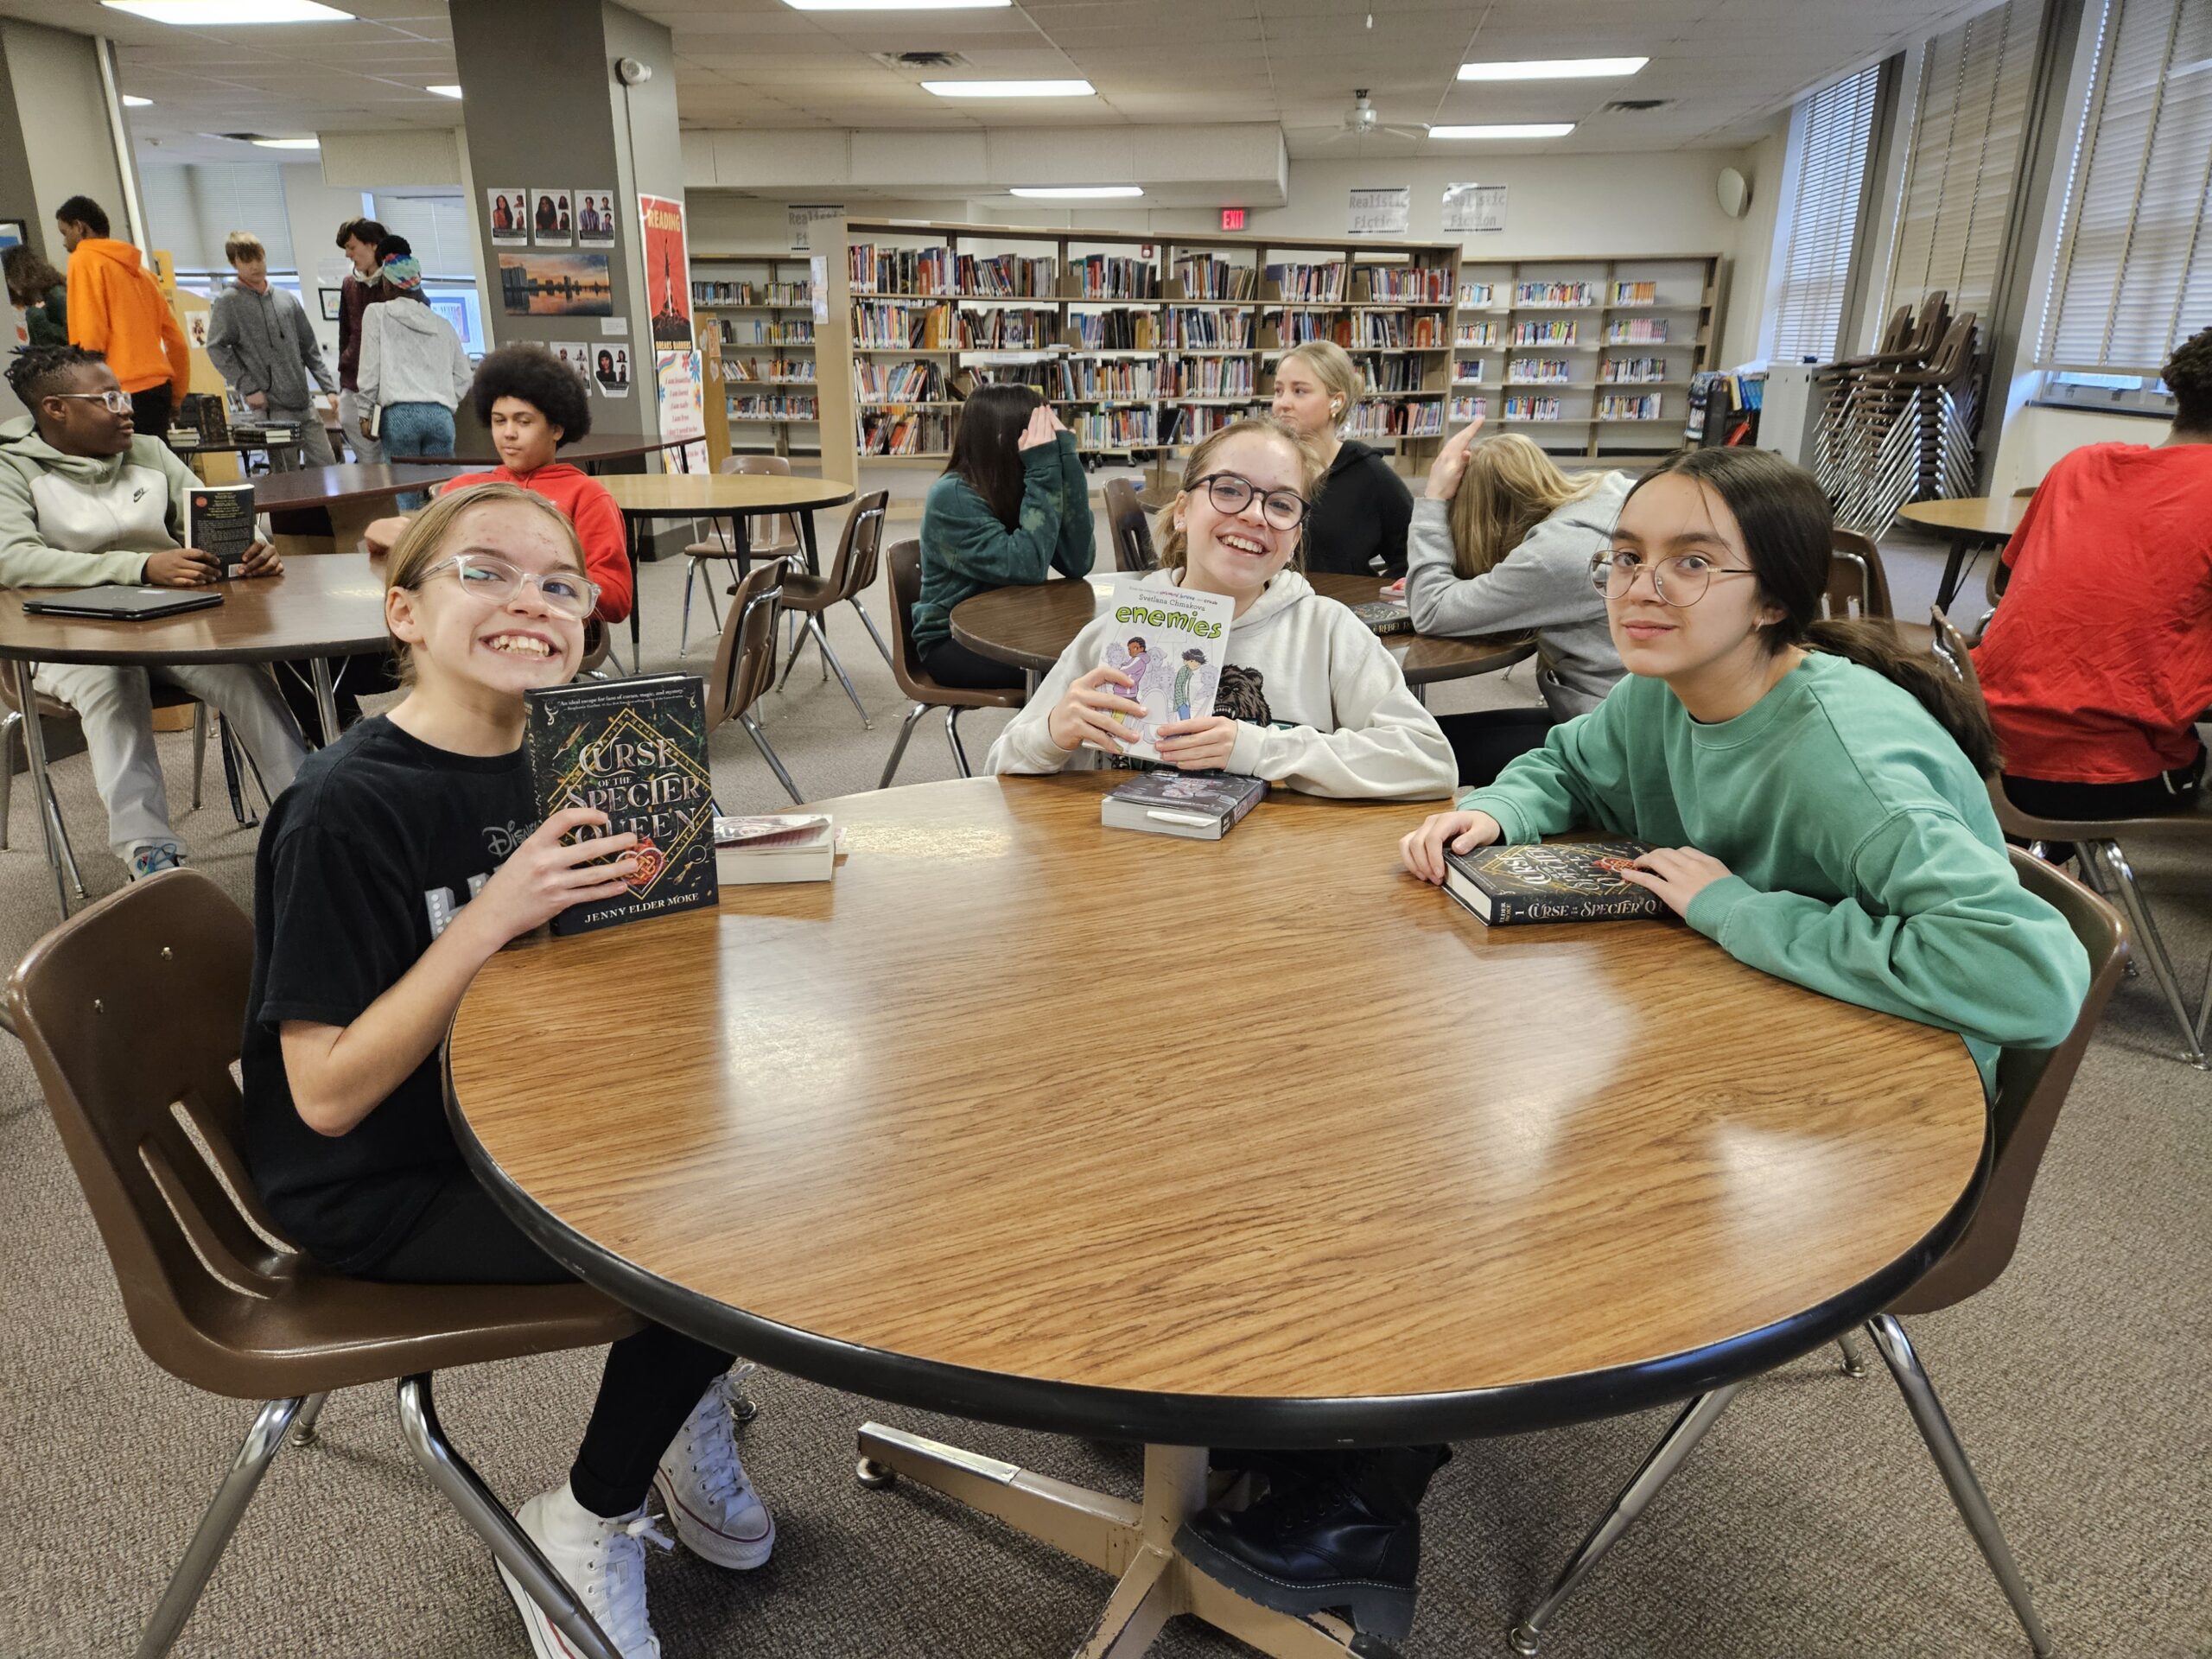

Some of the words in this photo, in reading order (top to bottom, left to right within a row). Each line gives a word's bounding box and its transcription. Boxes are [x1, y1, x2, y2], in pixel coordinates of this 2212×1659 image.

[1349, 194, 1407, 209] Realistic
[647, 208, 681, 233] READING
[1223, 210, 1244, 231] EXIT
[1139, 594, 1167, 605] Svetlana
[1169, 599, 1205, 612] Chmakova
[1116, 607, 1222, 639] enemies
[579, 736, 679, 778] CURSE
[564, 772, 701, 813] SPECTER
[613, 776, 633, 786] THE
[584, 906, 626, 923] JENNY
[629, 899, 665, 914] ELDER
[668, 893, 699, 906] MOKE
[1528, 903, 1569, 918] CURSE
[1580, 899, 1640, 917] SPECTER
